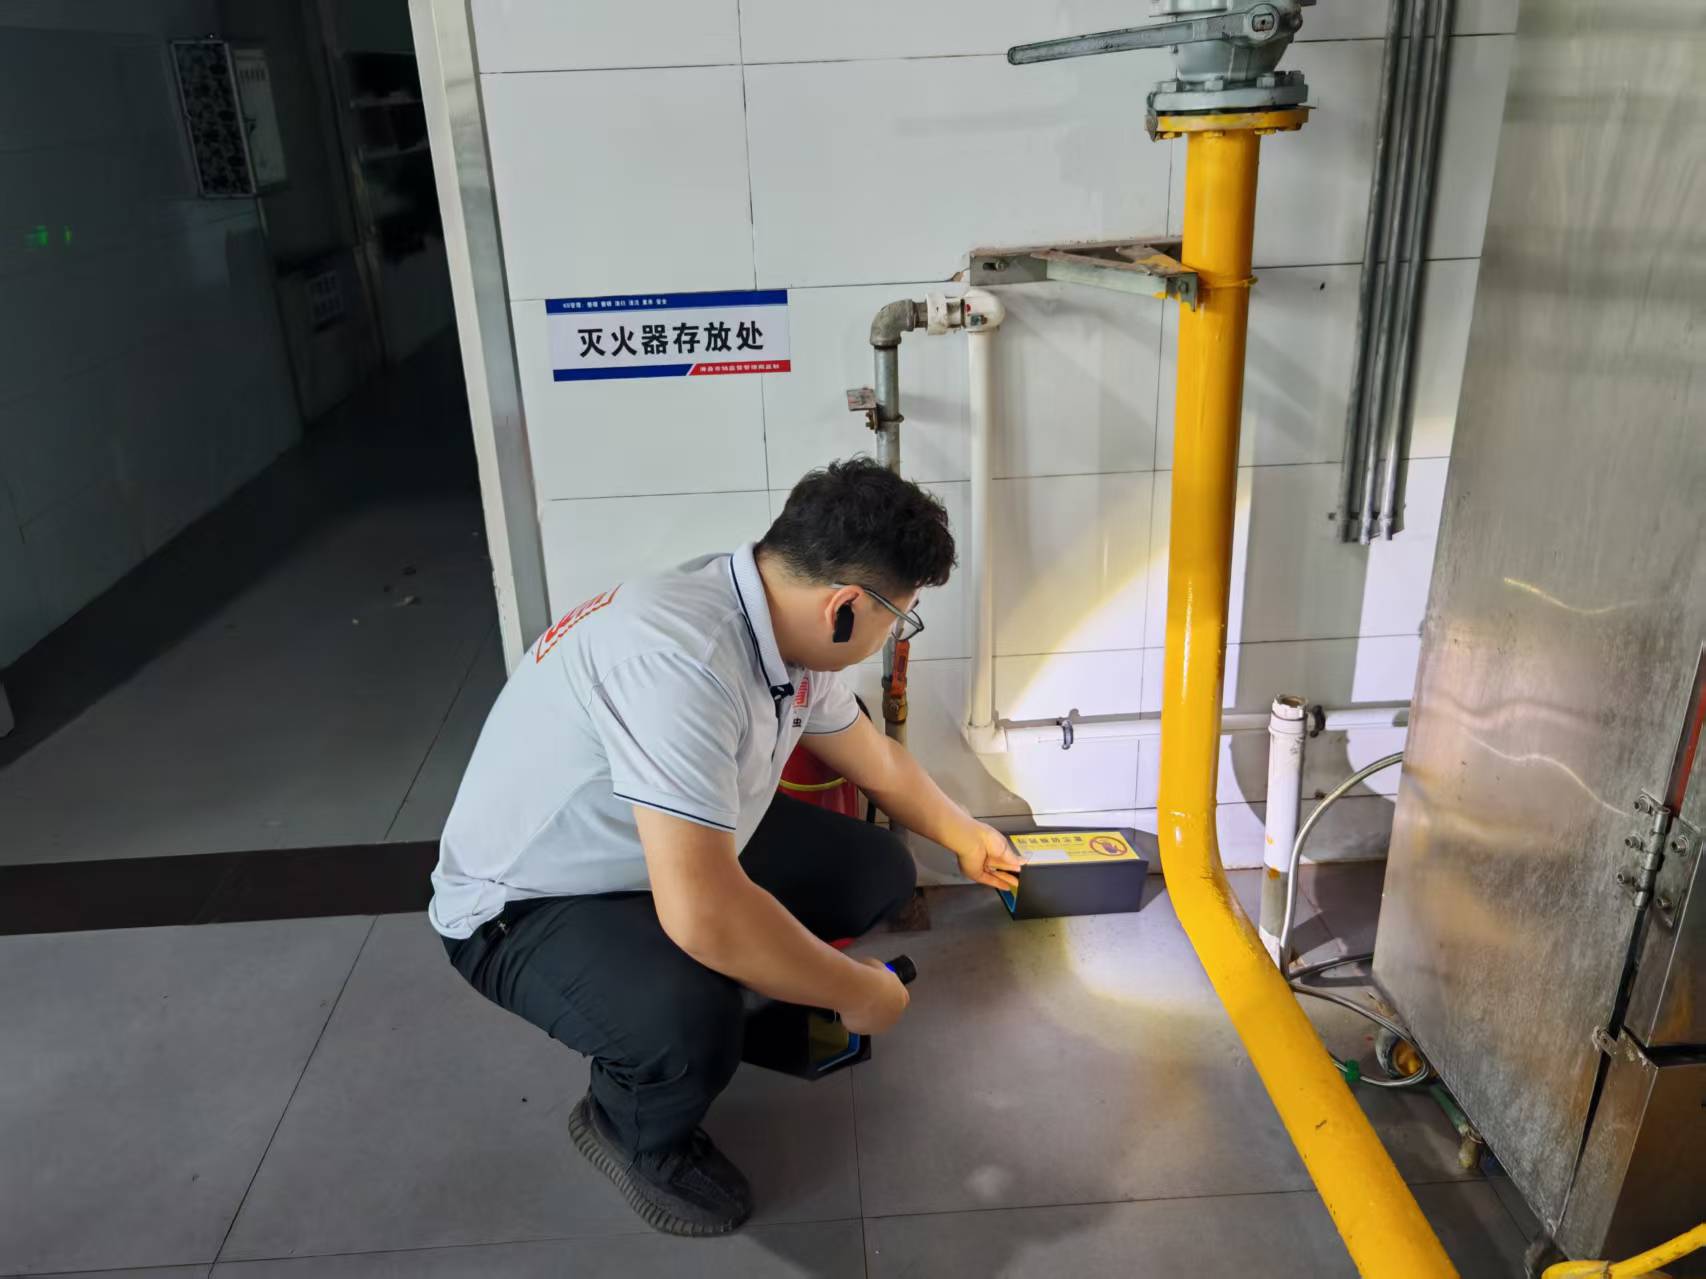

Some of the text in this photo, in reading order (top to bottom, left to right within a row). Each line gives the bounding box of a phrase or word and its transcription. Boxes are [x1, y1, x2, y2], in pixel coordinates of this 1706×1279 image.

[577, 320, 765, 358] 灭火器存放处
